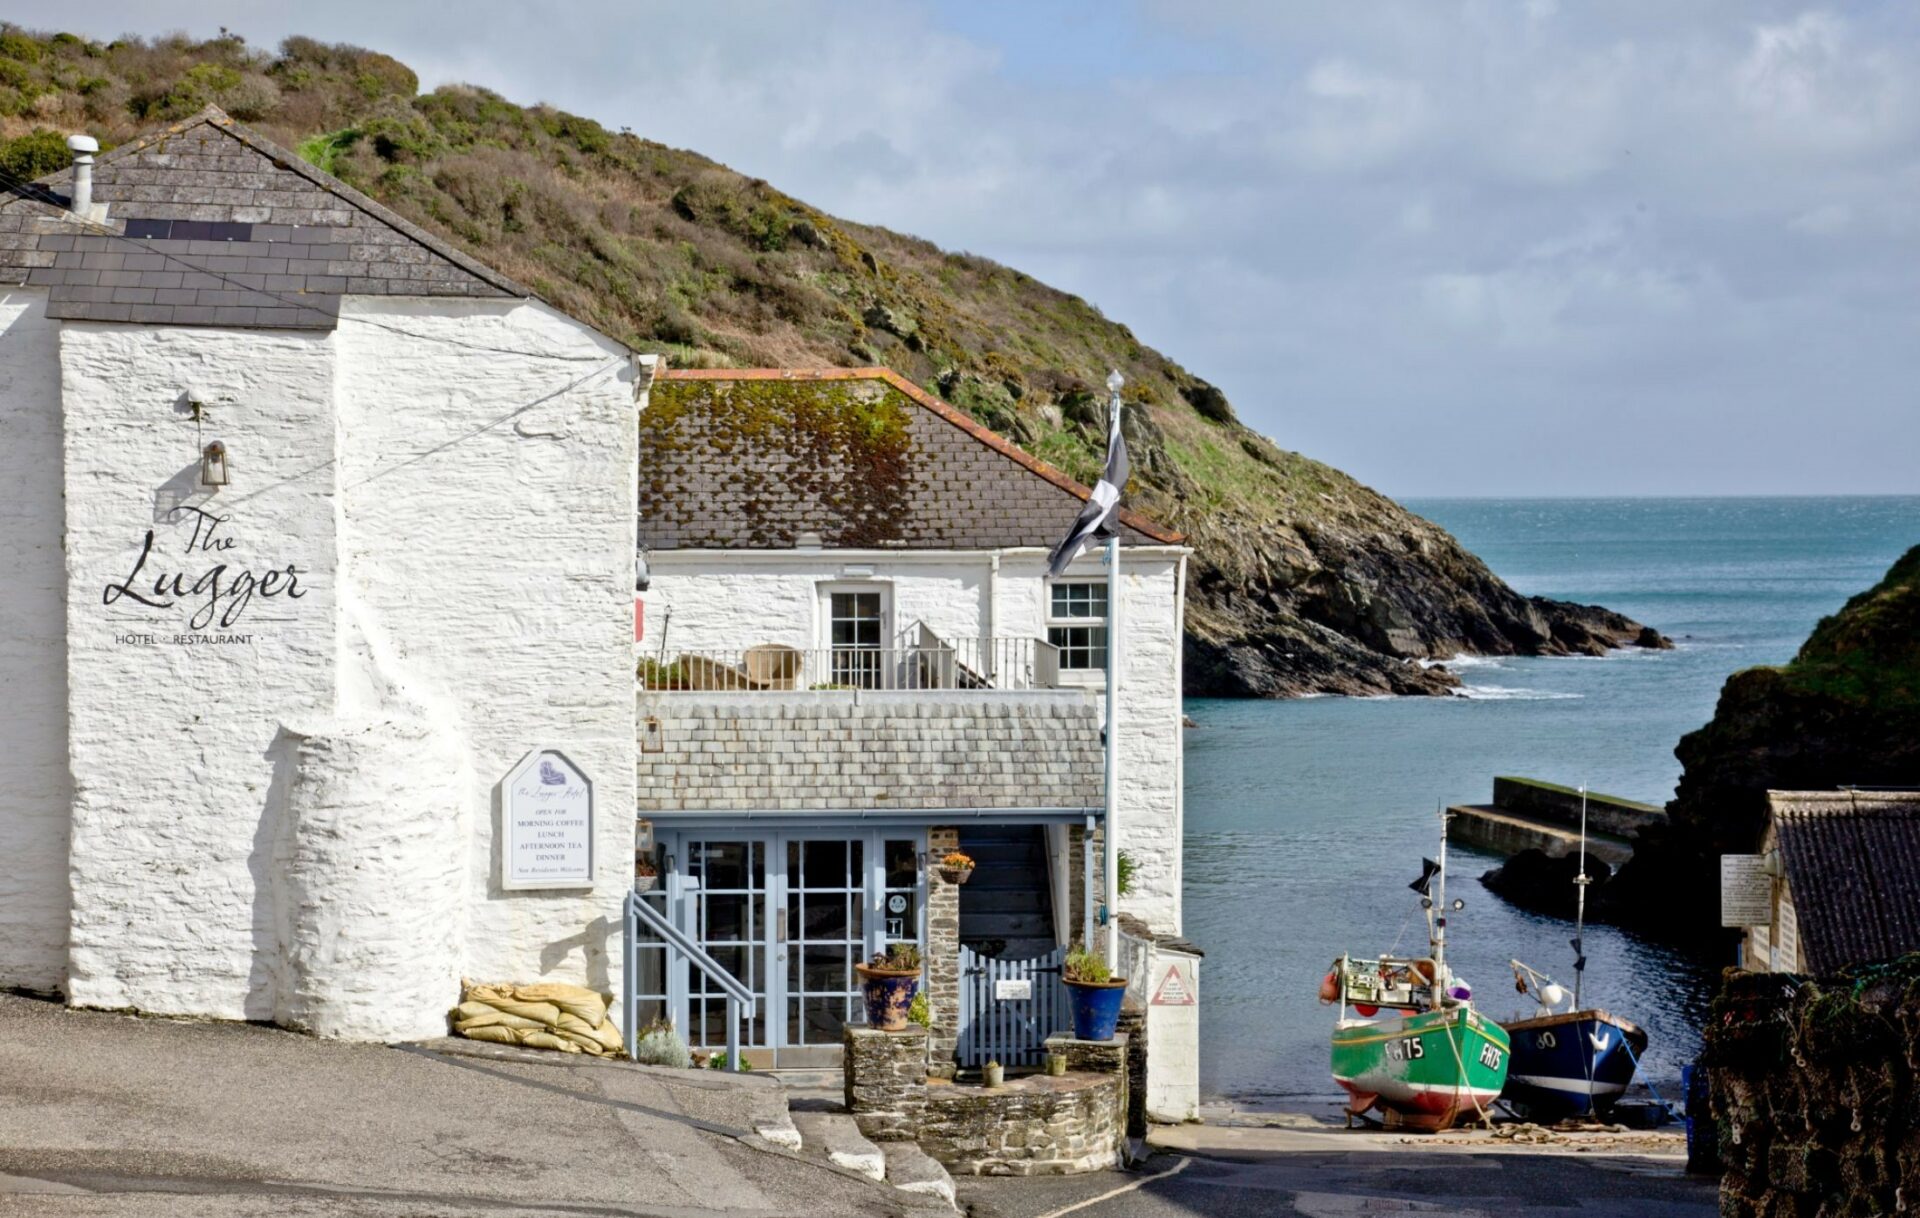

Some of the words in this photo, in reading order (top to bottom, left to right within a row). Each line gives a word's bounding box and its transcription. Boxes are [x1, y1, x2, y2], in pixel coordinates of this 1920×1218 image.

[167, 505, 237, 554] The
[103, 529, 307, 630] Lugger
[115, 634, 158, 645] HOTEL
[173, 634, 253, 645] RESTAURANT
[1479, 1042, 1502, 1071] FH75
